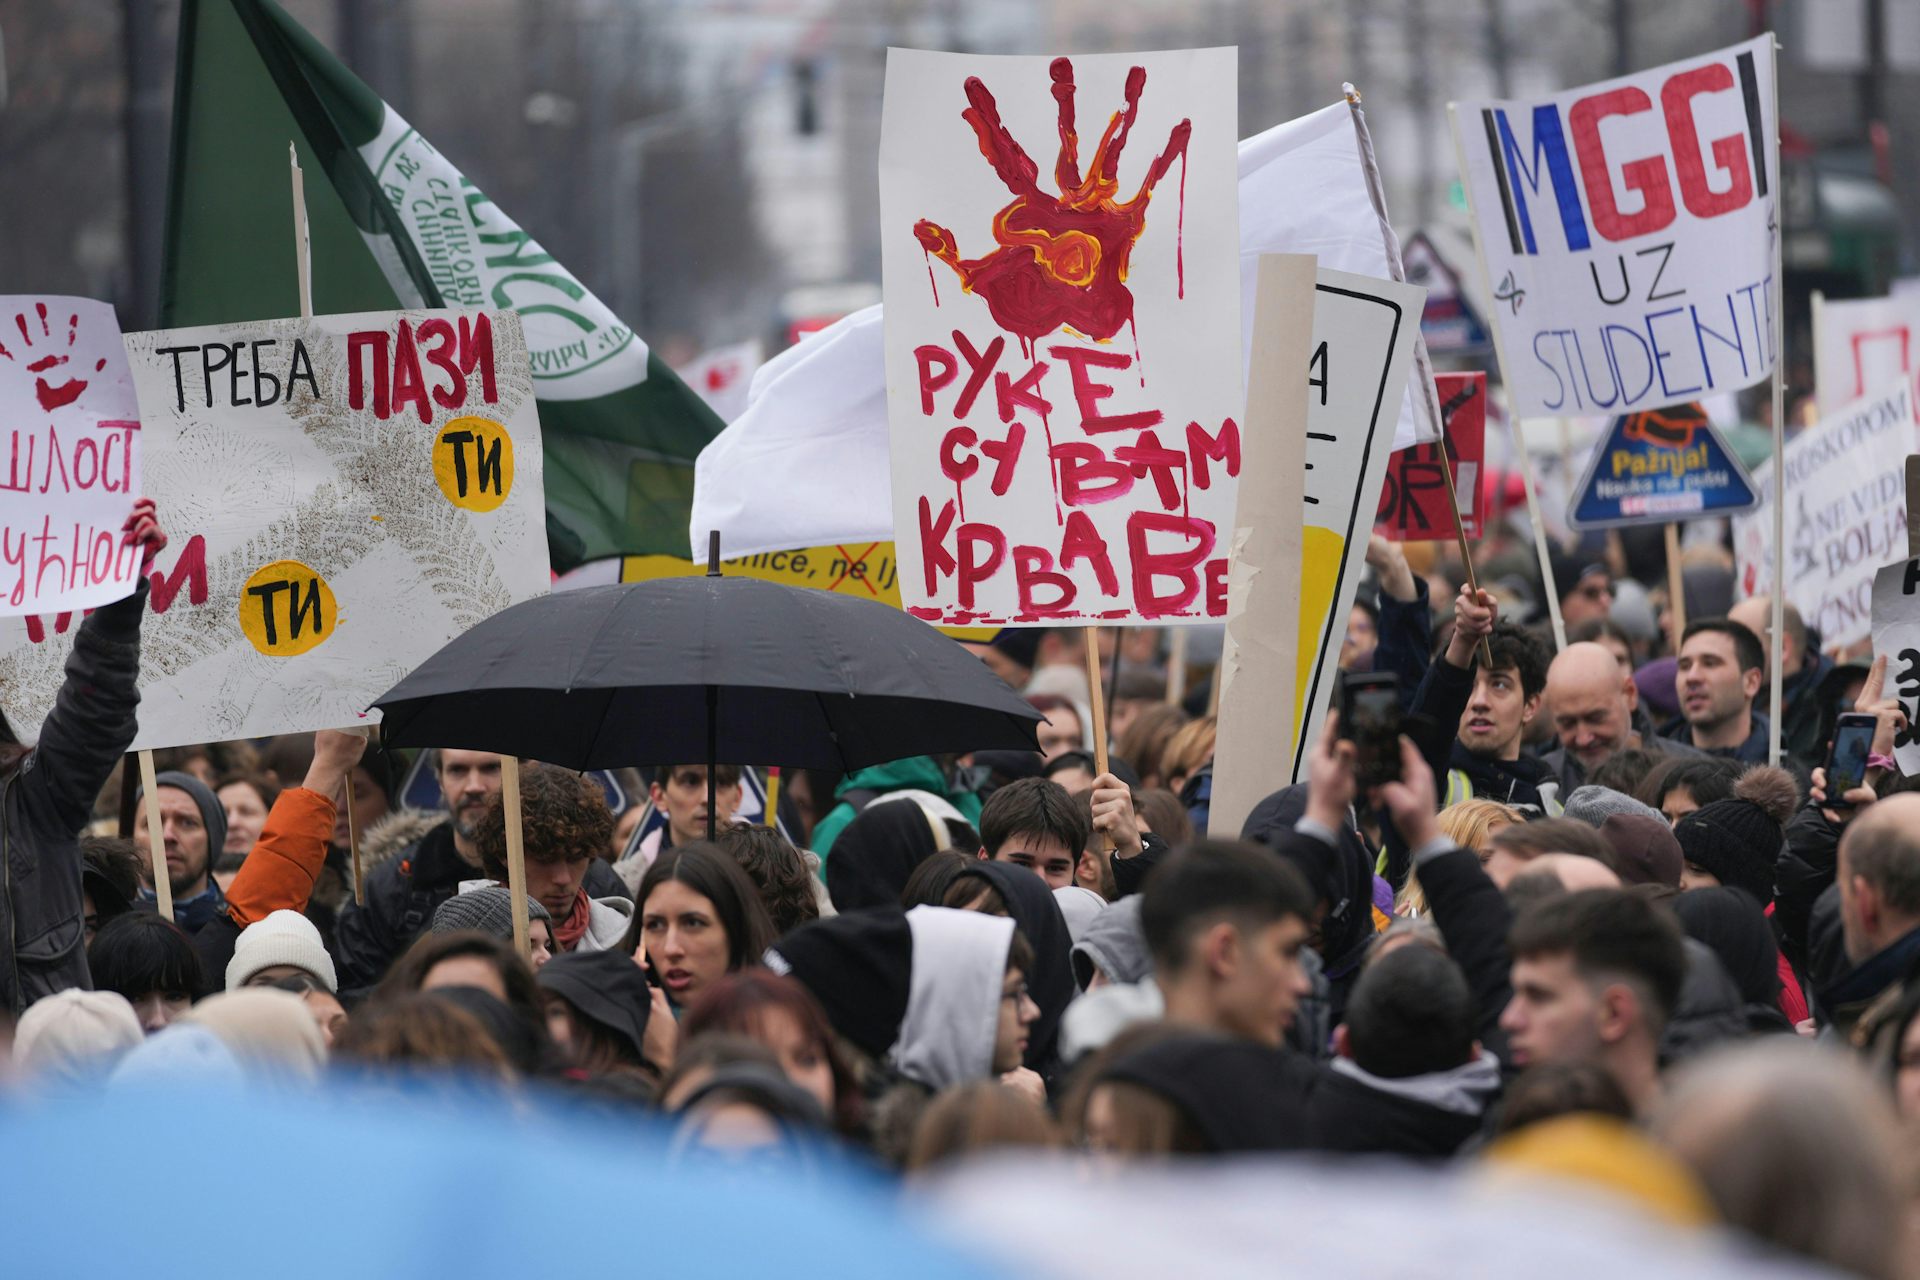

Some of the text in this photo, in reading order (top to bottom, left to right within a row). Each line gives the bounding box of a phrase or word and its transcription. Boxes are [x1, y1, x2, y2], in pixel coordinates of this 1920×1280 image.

[1590, 243, 1686, 304] UZ
[156, 312, 499, 424] ТРЕБА ПАЗИ
[913, 329, 1163, 435] РУКЕ
[442, 430, 503, 497] ТИ
[940, 421, 1026, 496] СУ
[1049, 417, 1241, 510] ВАМ
[247, 578, 323, 646] ТИ
